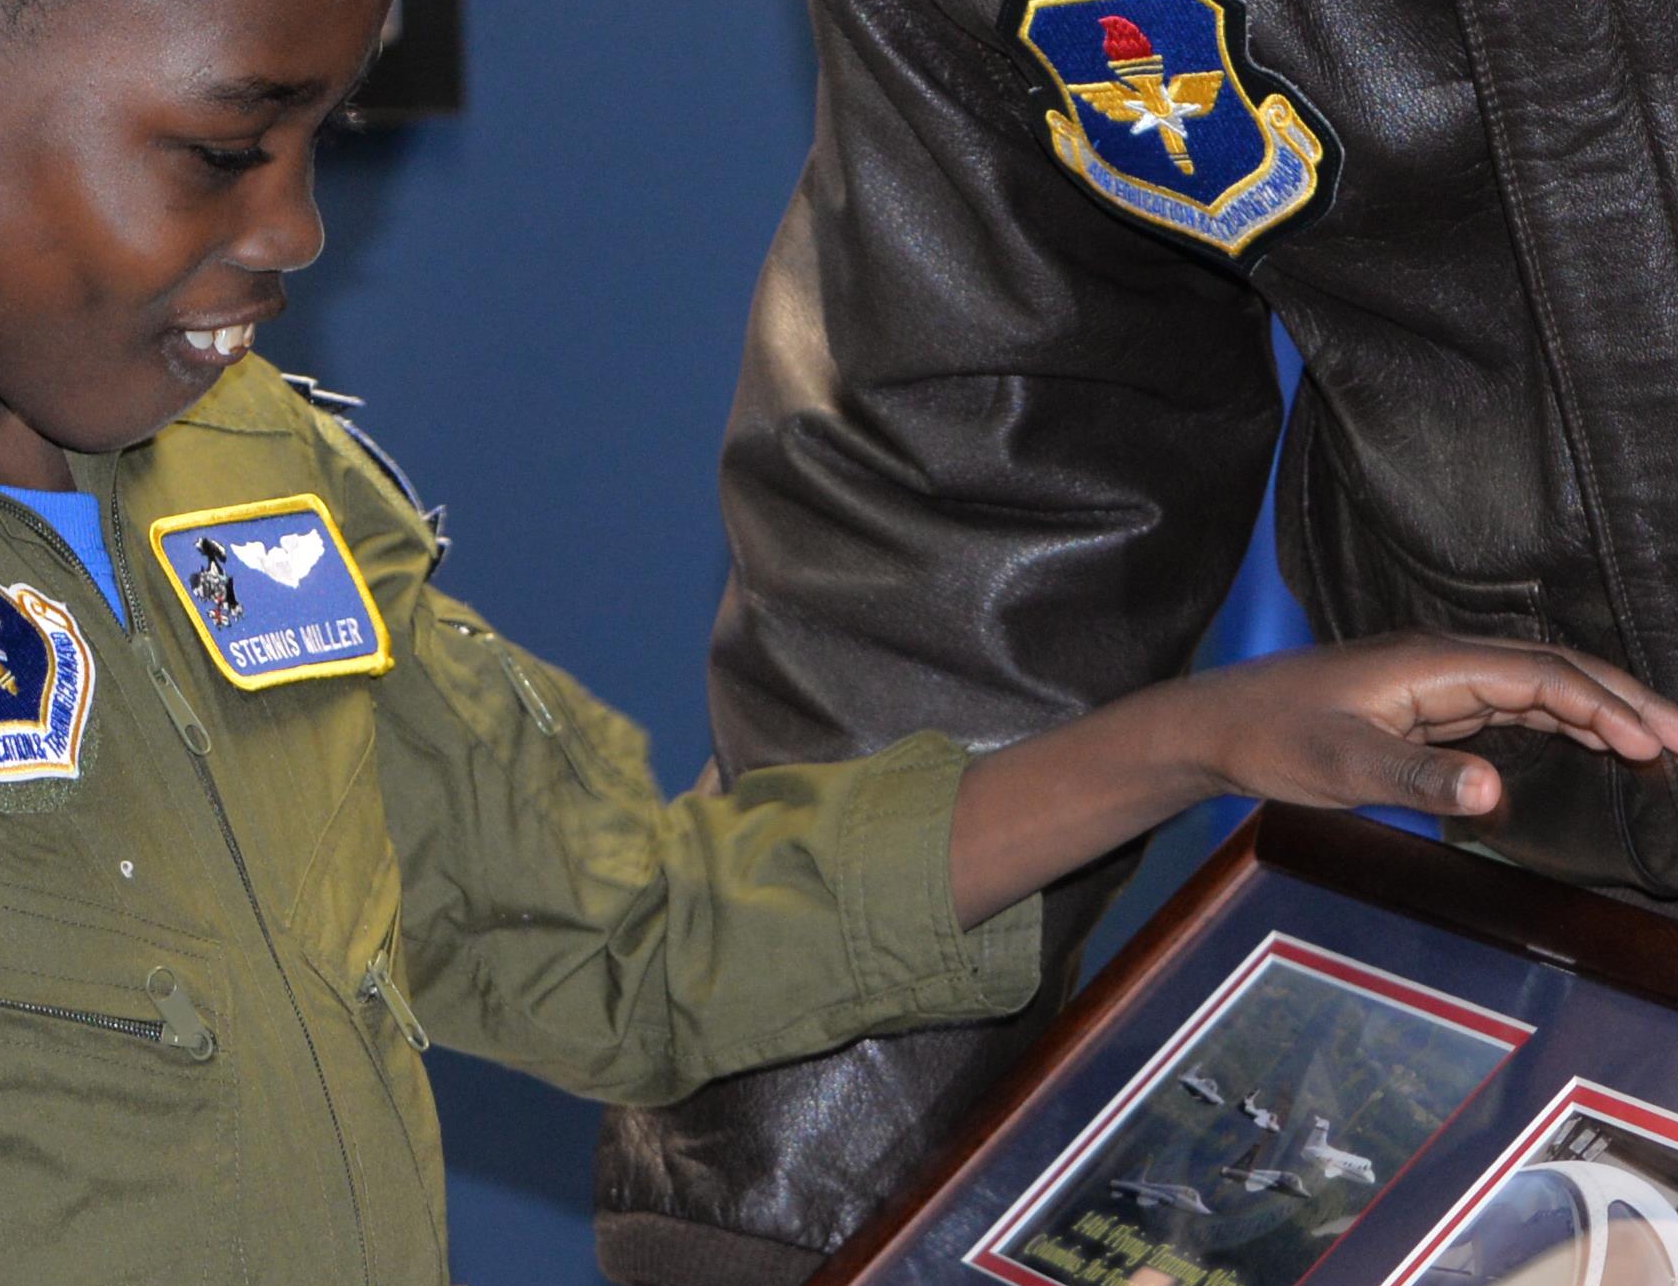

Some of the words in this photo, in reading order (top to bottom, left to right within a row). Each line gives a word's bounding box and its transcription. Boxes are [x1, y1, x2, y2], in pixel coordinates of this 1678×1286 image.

[229, 629, 301, 668] STENNIS
[299, 617, 364, 654] MILLER
[33, 732, 48, 760] &
